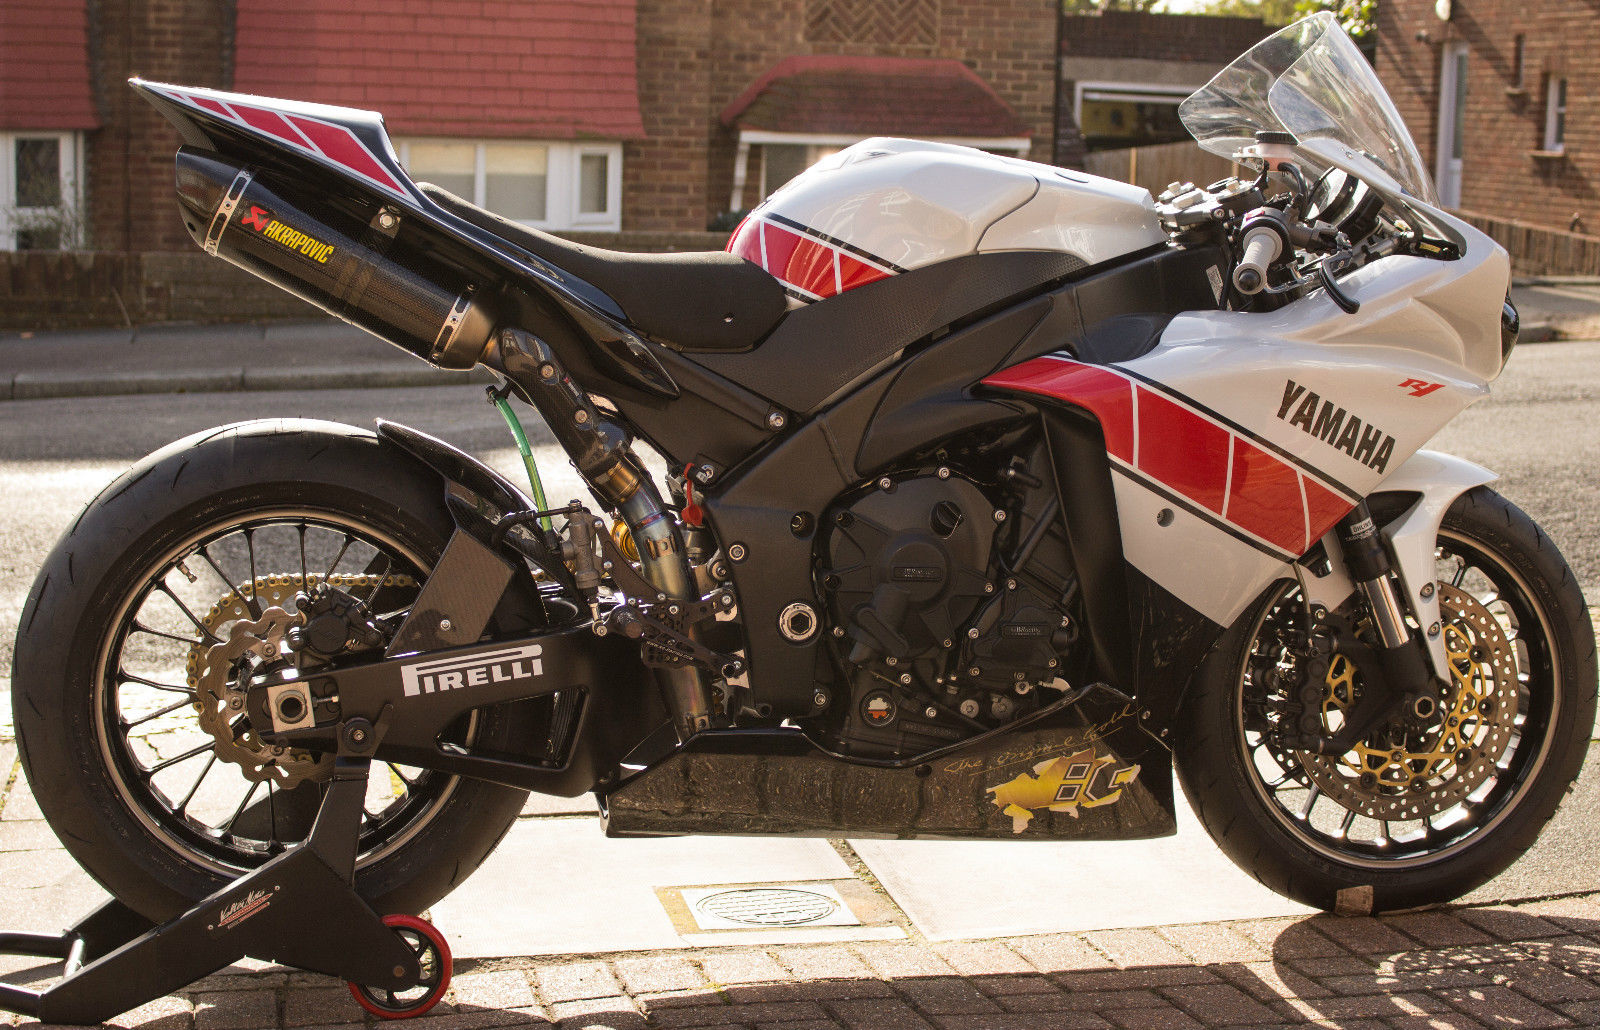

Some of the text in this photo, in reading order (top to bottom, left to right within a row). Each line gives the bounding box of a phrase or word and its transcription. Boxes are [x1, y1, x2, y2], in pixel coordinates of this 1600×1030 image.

[263, 220, 335, 264] AKRAPOVIČ
[1276, 379, 1396, 475] YAMAHA
[400, 643, 544, 697] PIRELLI
